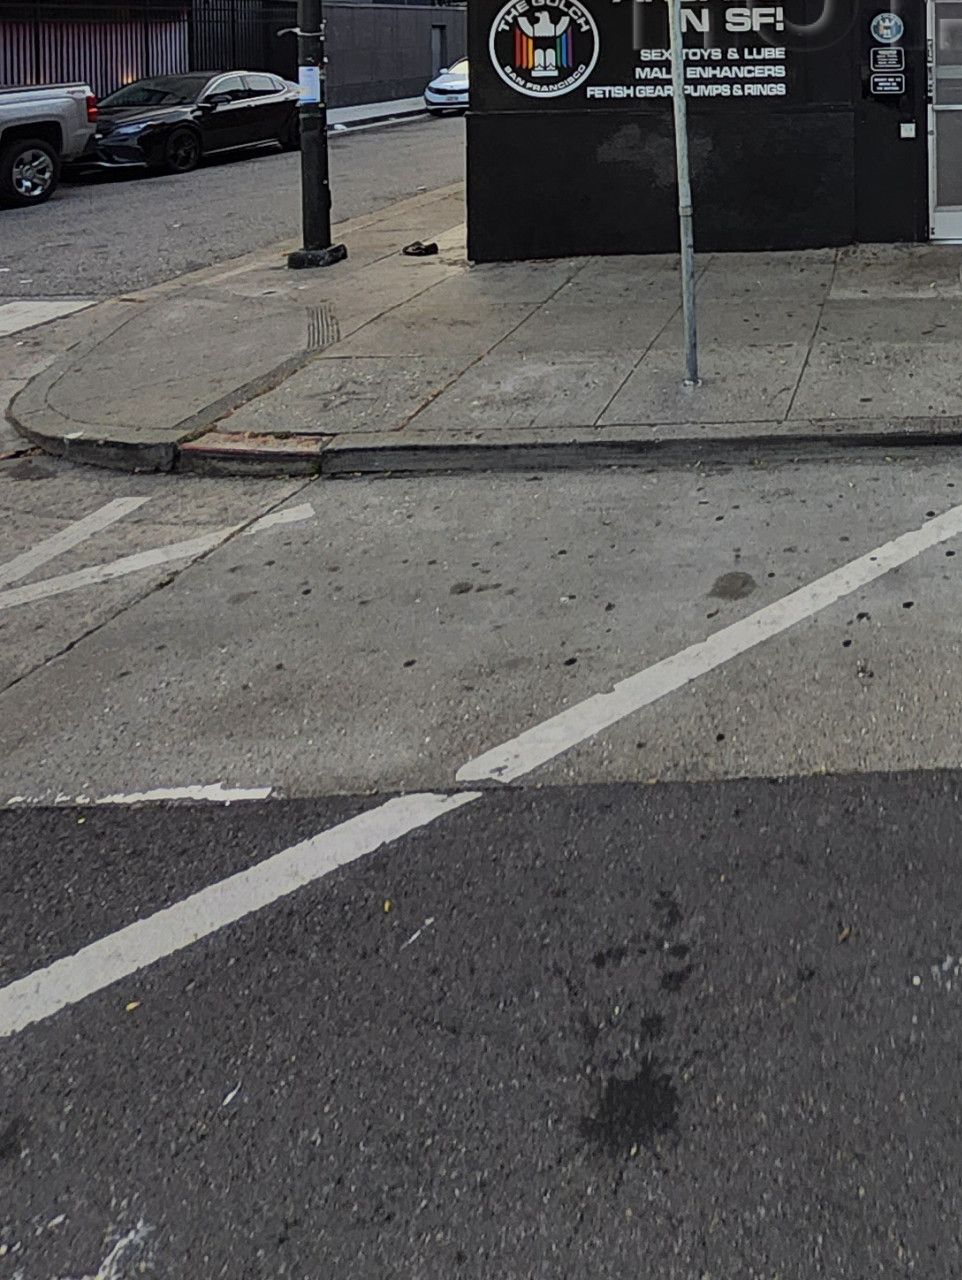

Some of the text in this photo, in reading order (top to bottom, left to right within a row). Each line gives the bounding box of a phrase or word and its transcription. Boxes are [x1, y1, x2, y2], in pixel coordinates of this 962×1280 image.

[498, 0, 530, 32] THE
[681, 7, 784, 32] N SF!
[640, 48, 672, 61] SEX
[727, 48, 739, 60] &
[744, 47, 786, 59] LUBE
[504, 64, 586, 92] SAN FRANCISCO
[635, 65, 786, 80] MAL ENHANCERS
[586, 86, 634, 98] FETISH
[732, 85, 743, 96] &
[744, 83, 786, 96] RINGS
